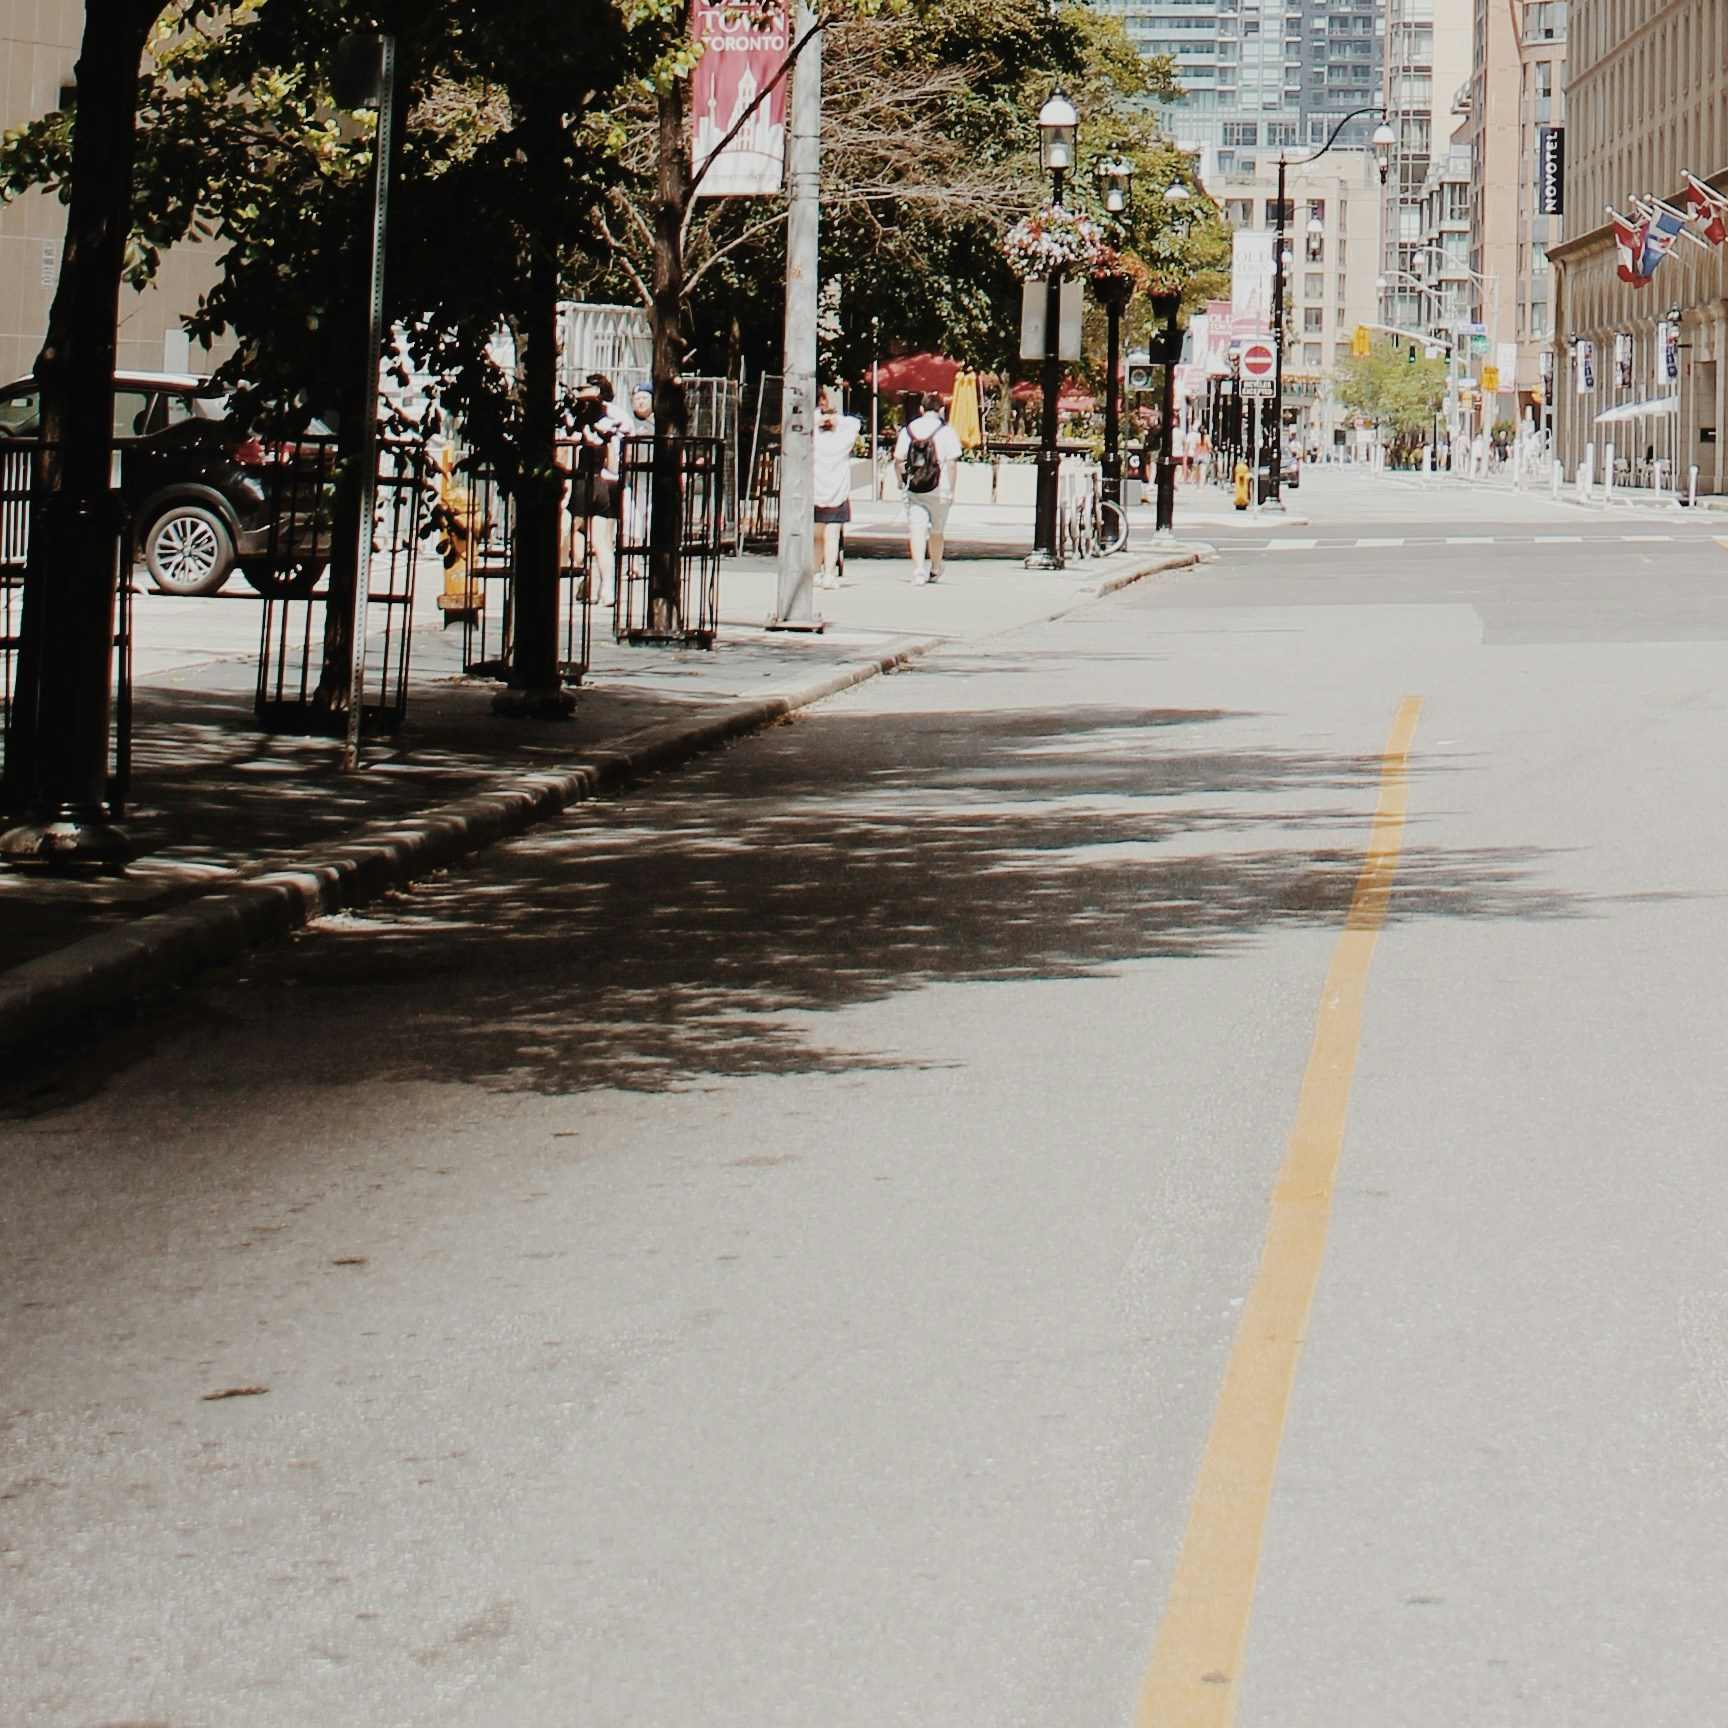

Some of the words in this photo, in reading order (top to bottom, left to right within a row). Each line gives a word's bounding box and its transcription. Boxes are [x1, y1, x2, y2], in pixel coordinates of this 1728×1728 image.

[698, 10, 785, 33] TOWN
[702, 35, 785, 52] TORONTO
[1545, 131, 1558, 213] NOVOTEL
[1236, 251, 1270, 263] OLD
